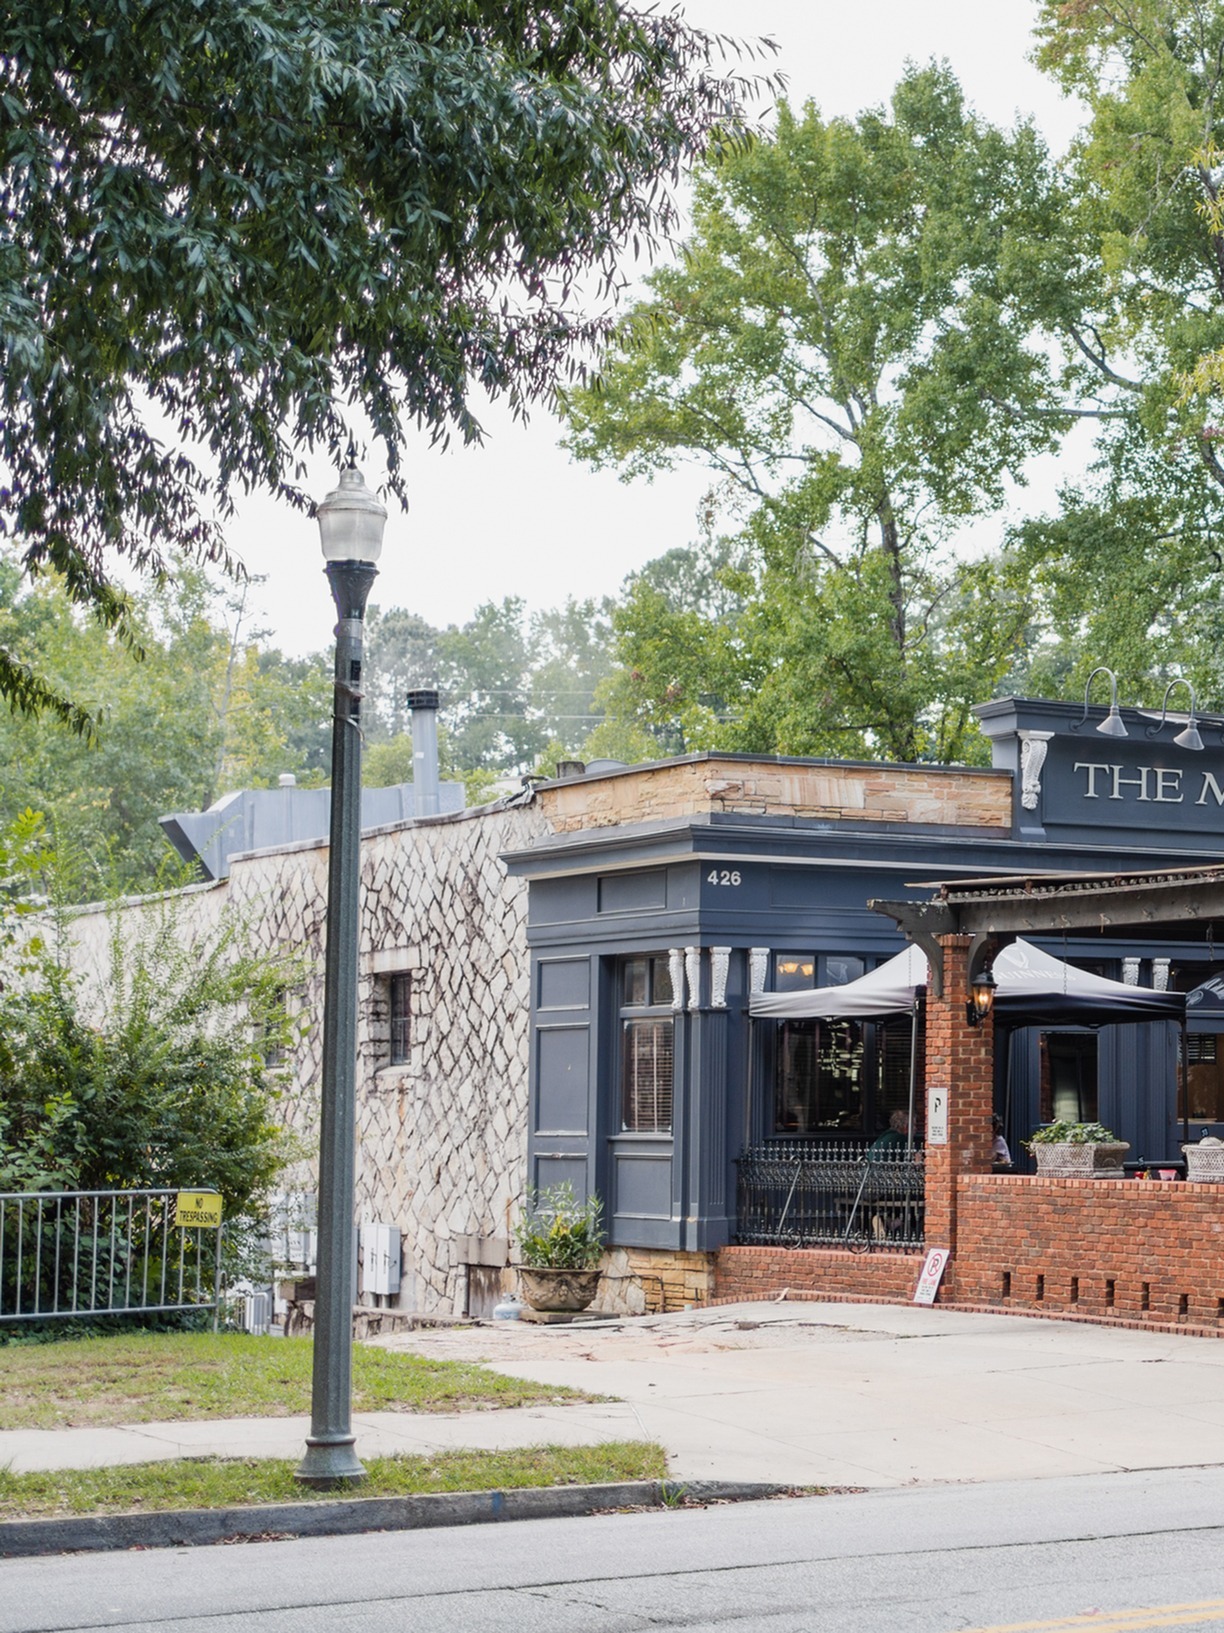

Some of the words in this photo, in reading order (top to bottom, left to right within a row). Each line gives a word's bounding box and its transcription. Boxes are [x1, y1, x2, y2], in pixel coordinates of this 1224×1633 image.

[1074, 762, 1184, 803] THE
[707, 870, 742, 886] 426
[196, 1198, 204, 1208] NO
[179, 1210, 218, 1224] TRESPASSING
